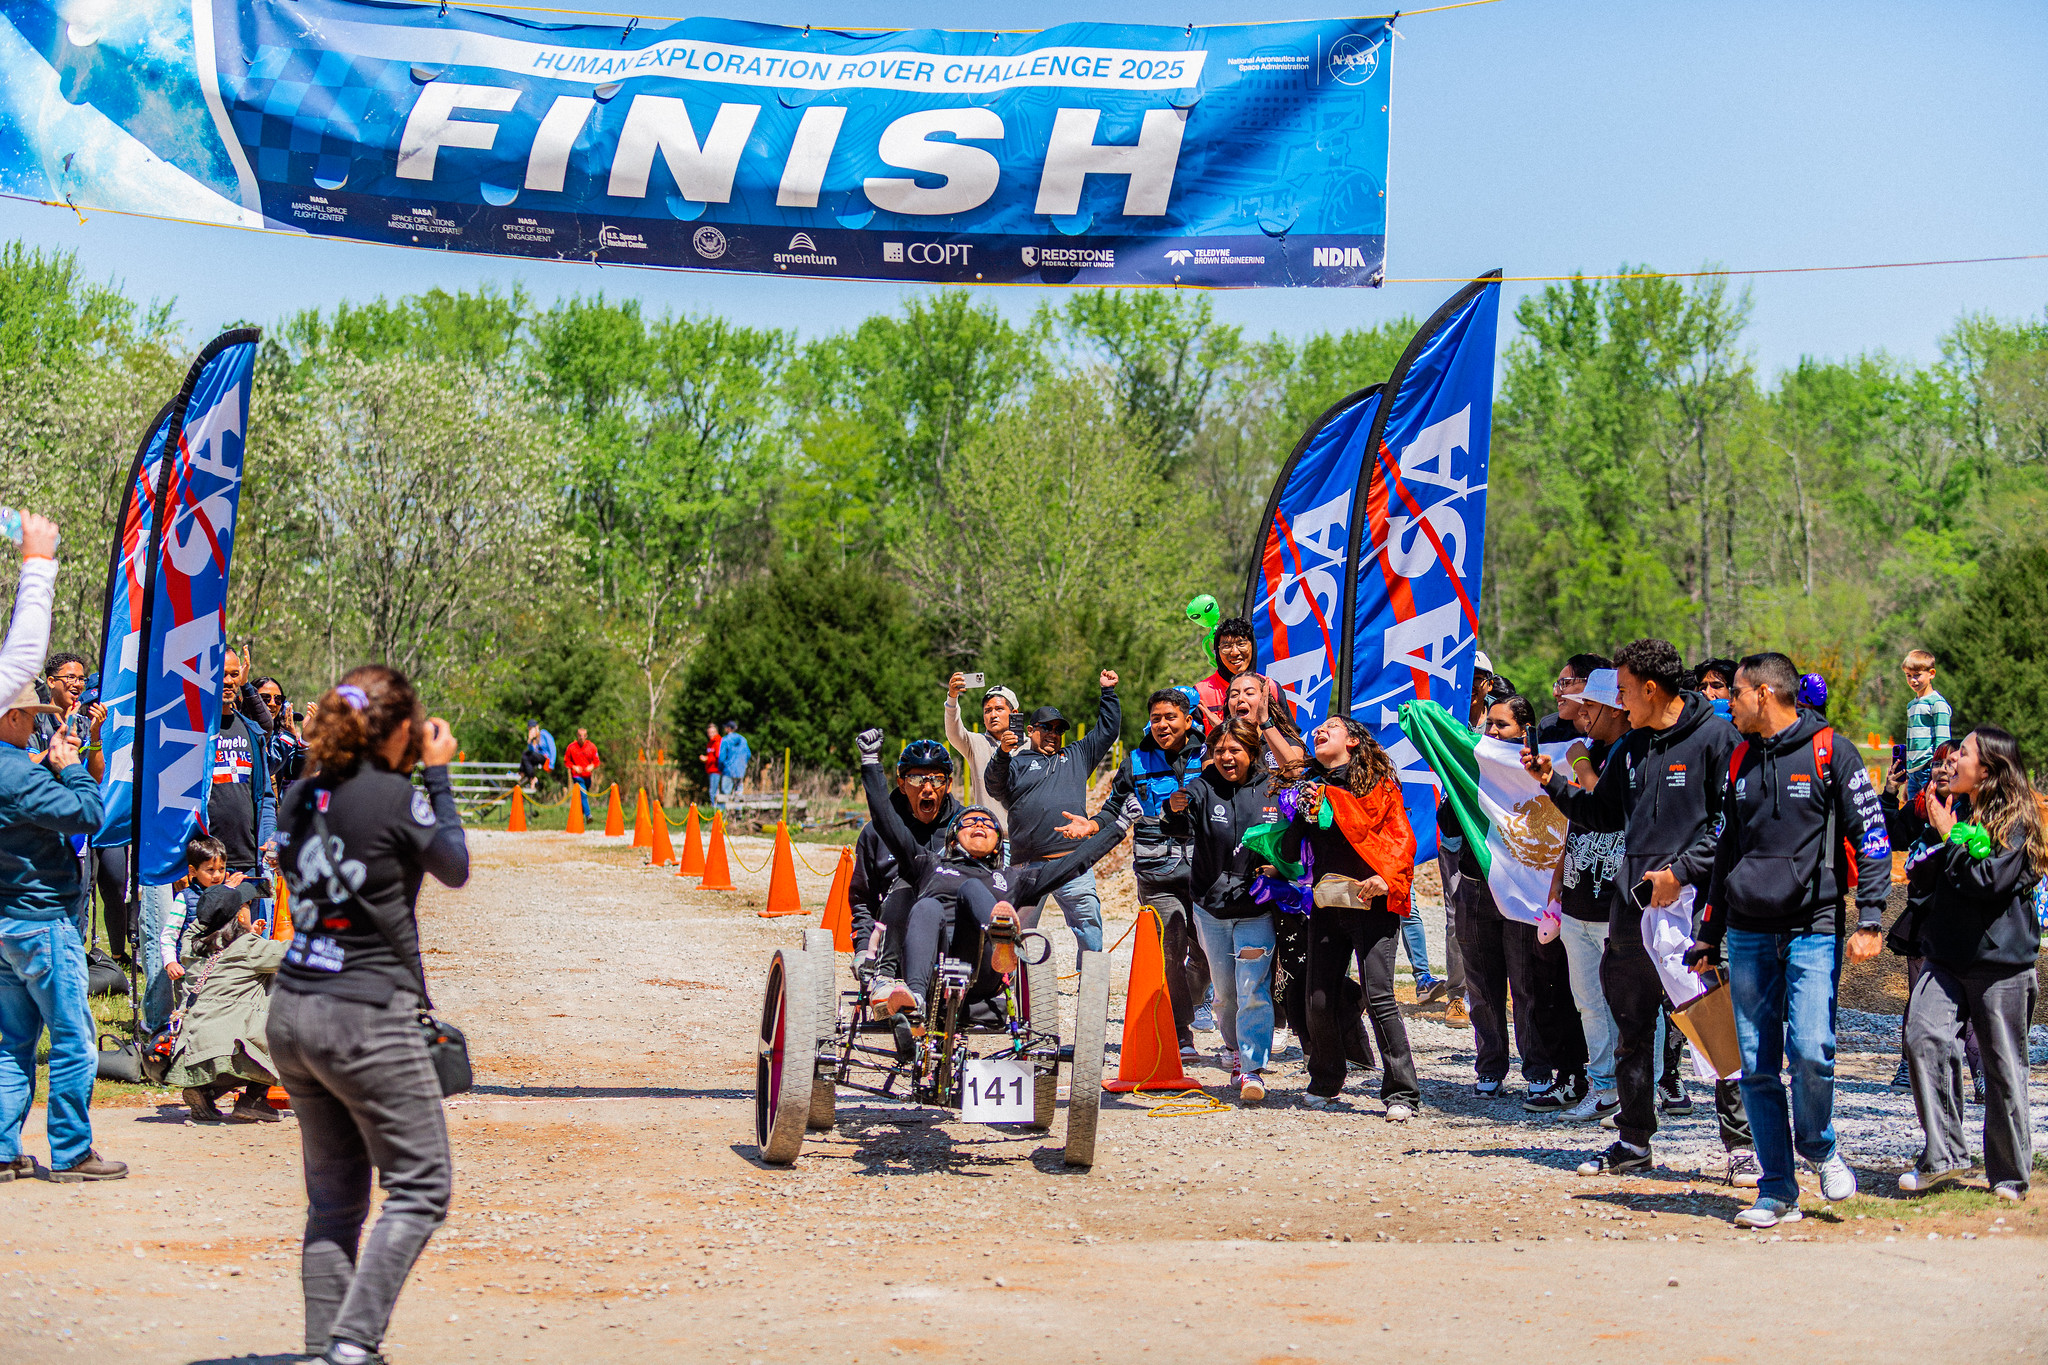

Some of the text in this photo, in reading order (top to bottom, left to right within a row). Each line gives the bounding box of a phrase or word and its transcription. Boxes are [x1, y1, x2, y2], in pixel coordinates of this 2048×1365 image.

[532, 47, 1186, 85] HUMAN EXPLORATION ROVER CHALLENGE 2025
[1227, 55, 1310, 65] National Aeronautics and
[1332, 54, 1376, 66] NASA
[1238, 62, 1310, 72] Space Administration
[395, 80, 1190, 218] FINISH
[309, 195, 329, 205] NASA
[291, 202, 348, 216] MARSHALL SPACE
[412, 207, 433, 217] NASA
[293, 210, 345, 223] FLIGHT CENTER
[391, 213, 456, 228] SPACE OPETIONS
[517, 217, 538, 226] NASA
[387, 220, 415, 231] MISSION
[502, 224, 555, 235] OFFICE OF STEM
[506, 232, 552, 243] ENGAGEMENT
[606, 231, 644, 242] U.S. Space &
[773, 251, 838, 266] amentum
[907, 242, 974, 266] COPT
[1041, 249, 1115, 262] REDSTONE
[1194, 248, 1231, 257] TELEDYNE
[1312, 247, 1367, 267] NDIA
[1041, 260, 1069, 268] FEDERAL
[1093, 261, 1115, 269] UNION
[1194, 256, 1265, 265] BROWN ENGINEERING
[158, 382, 241, 815] NASA
[1265, 488, 1352, 746] ASA
[968, 1076, 1023, 1106] 141
